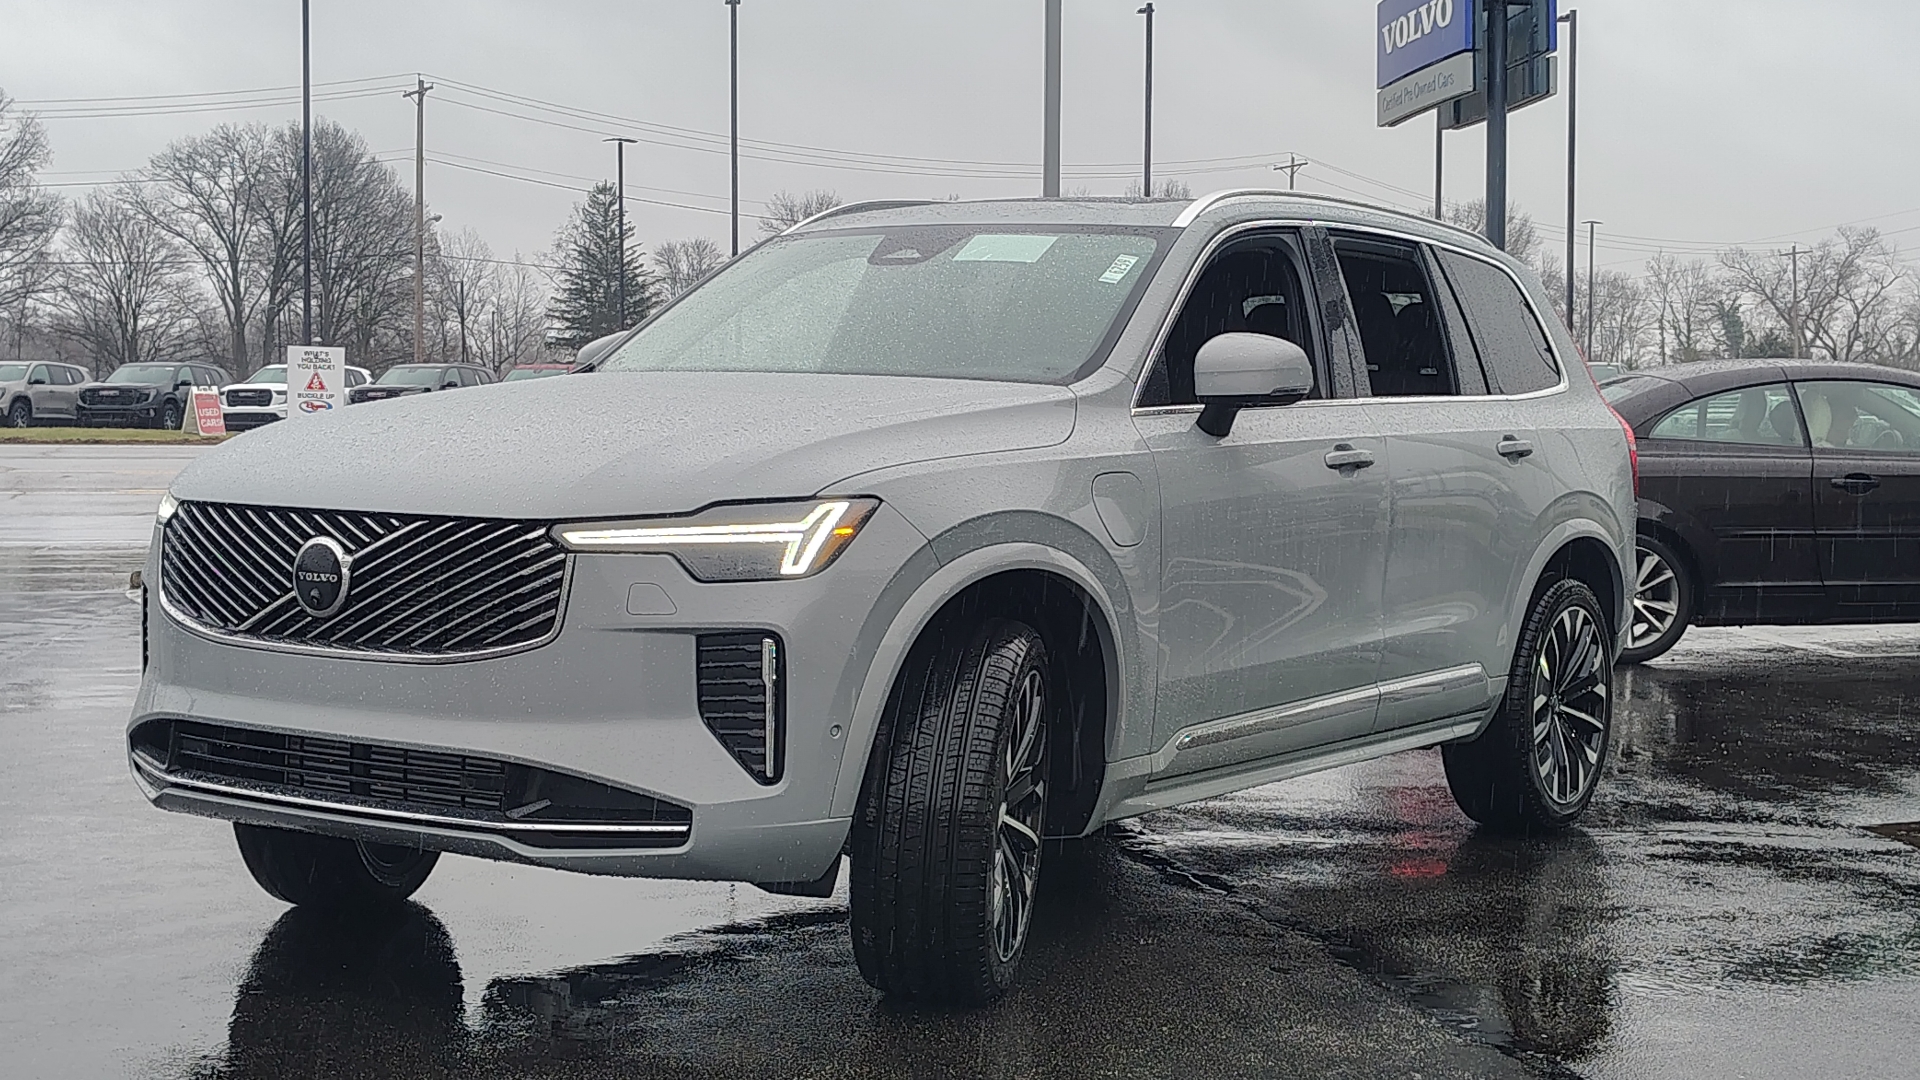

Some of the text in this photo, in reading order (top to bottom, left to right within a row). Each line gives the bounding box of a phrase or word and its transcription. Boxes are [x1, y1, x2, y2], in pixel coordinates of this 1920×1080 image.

[1381, 0, 1453, 54] VOLVO
[1437, 71, 1455, 89] Cars
[199, 408, 219, 417] USED
[298, 571, 338, 583] VOLVO
